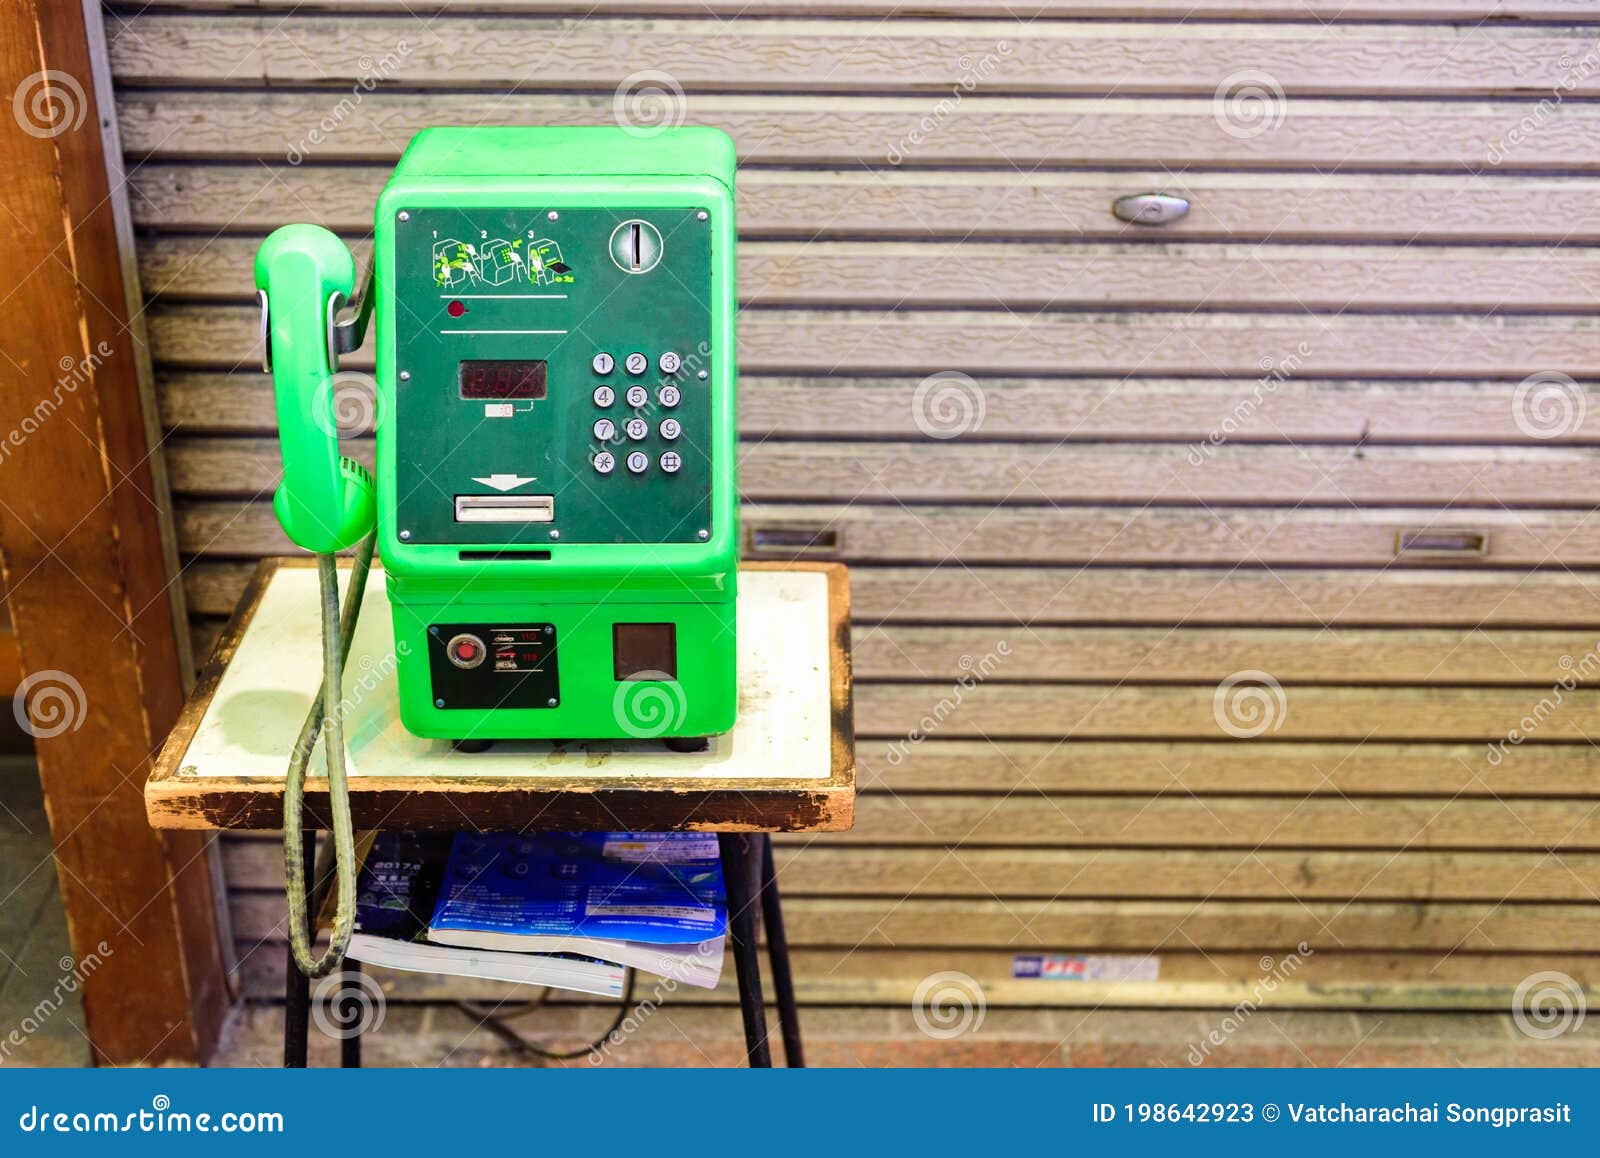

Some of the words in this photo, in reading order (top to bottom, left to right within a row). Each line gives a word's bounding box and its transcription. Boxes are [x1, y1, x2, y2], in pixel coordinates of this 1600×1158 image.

[433, 230, 437, 238] 1
[481, 230, 487, 238] 2
[528, 230, 534, 238] 3
[600, 357, 606, 370] 1
[631, 356, 641, 371] 2
[664, 355, 675, 370] 3
[598, 390, 609, 403] 4
[631, 390, 642, 403] 5
[664, 389, 675, 403] 6
[599, 423, 609, 436] 7
[632, 422, 643, 436] 8
[665, 422, 676, 436] 9
[632, 455, 644, 469] 0
